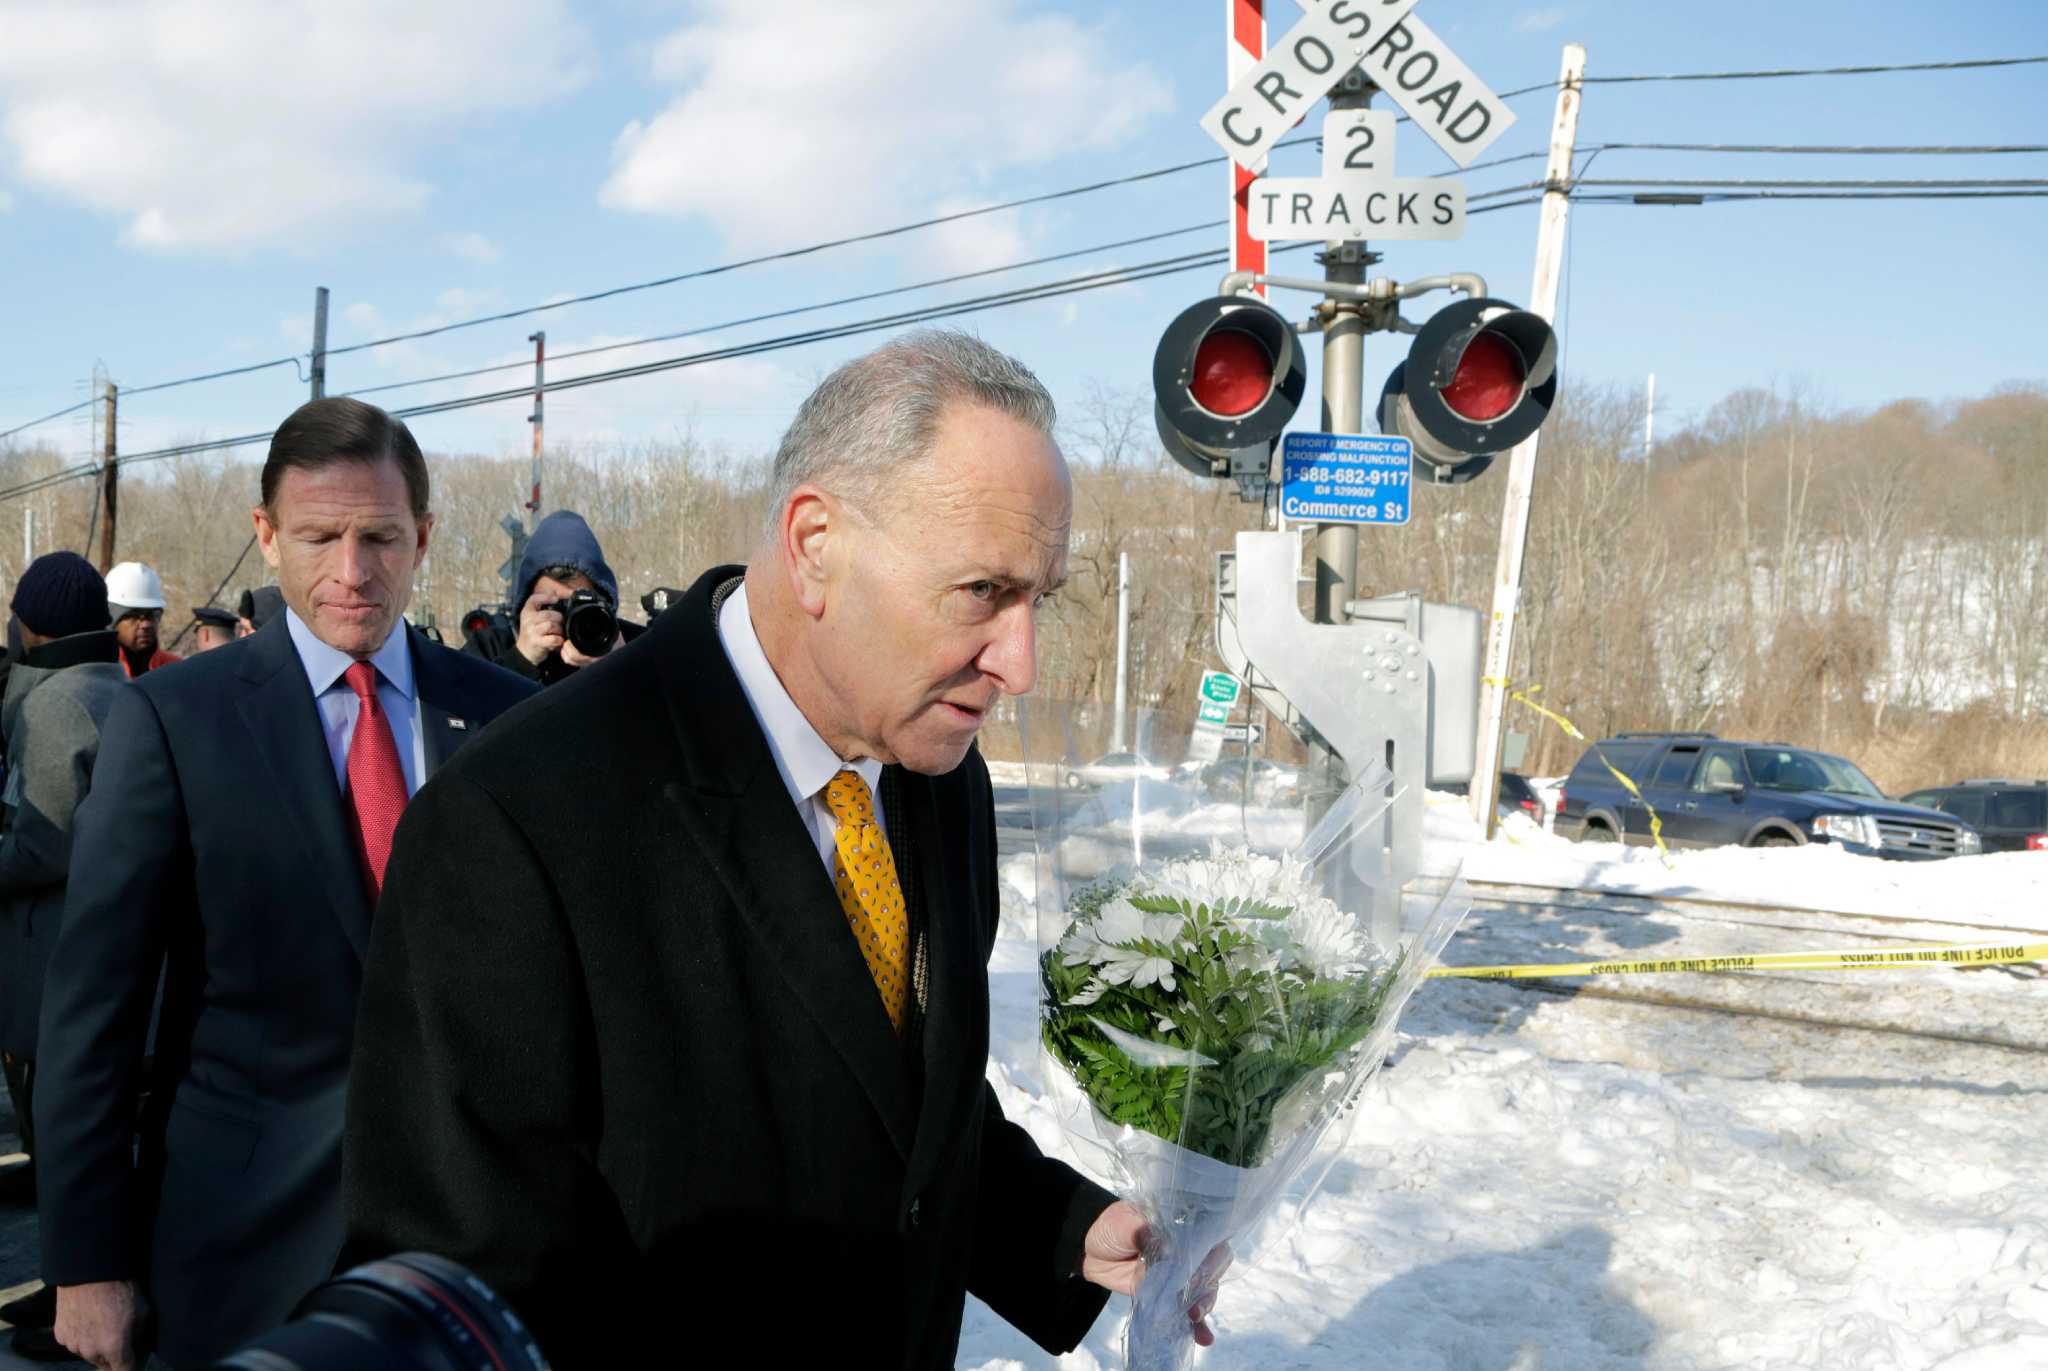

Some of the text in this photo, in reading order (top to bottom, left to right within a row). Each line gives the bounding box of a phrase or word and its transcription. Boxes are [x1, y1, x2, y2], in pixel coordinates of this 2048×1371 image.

[1222, 0, 1400, 147] CROS
[1344, 126, 1375, 169] 2
[1261, 193, 1454, 225] TRACKS
[1287, 438, 1408, 453] REPORT EMERGENCY OR
[1286, 451, 1408, 466] CROSSING MALFUNCTION
[1285, 466, 1409, 486] 1-888-682-9117
[1286, 497, 1403, 520] Commerce St
[1680, 960, 1707, 972] LINE
[1711, 958, 1755, 971] POLICE
